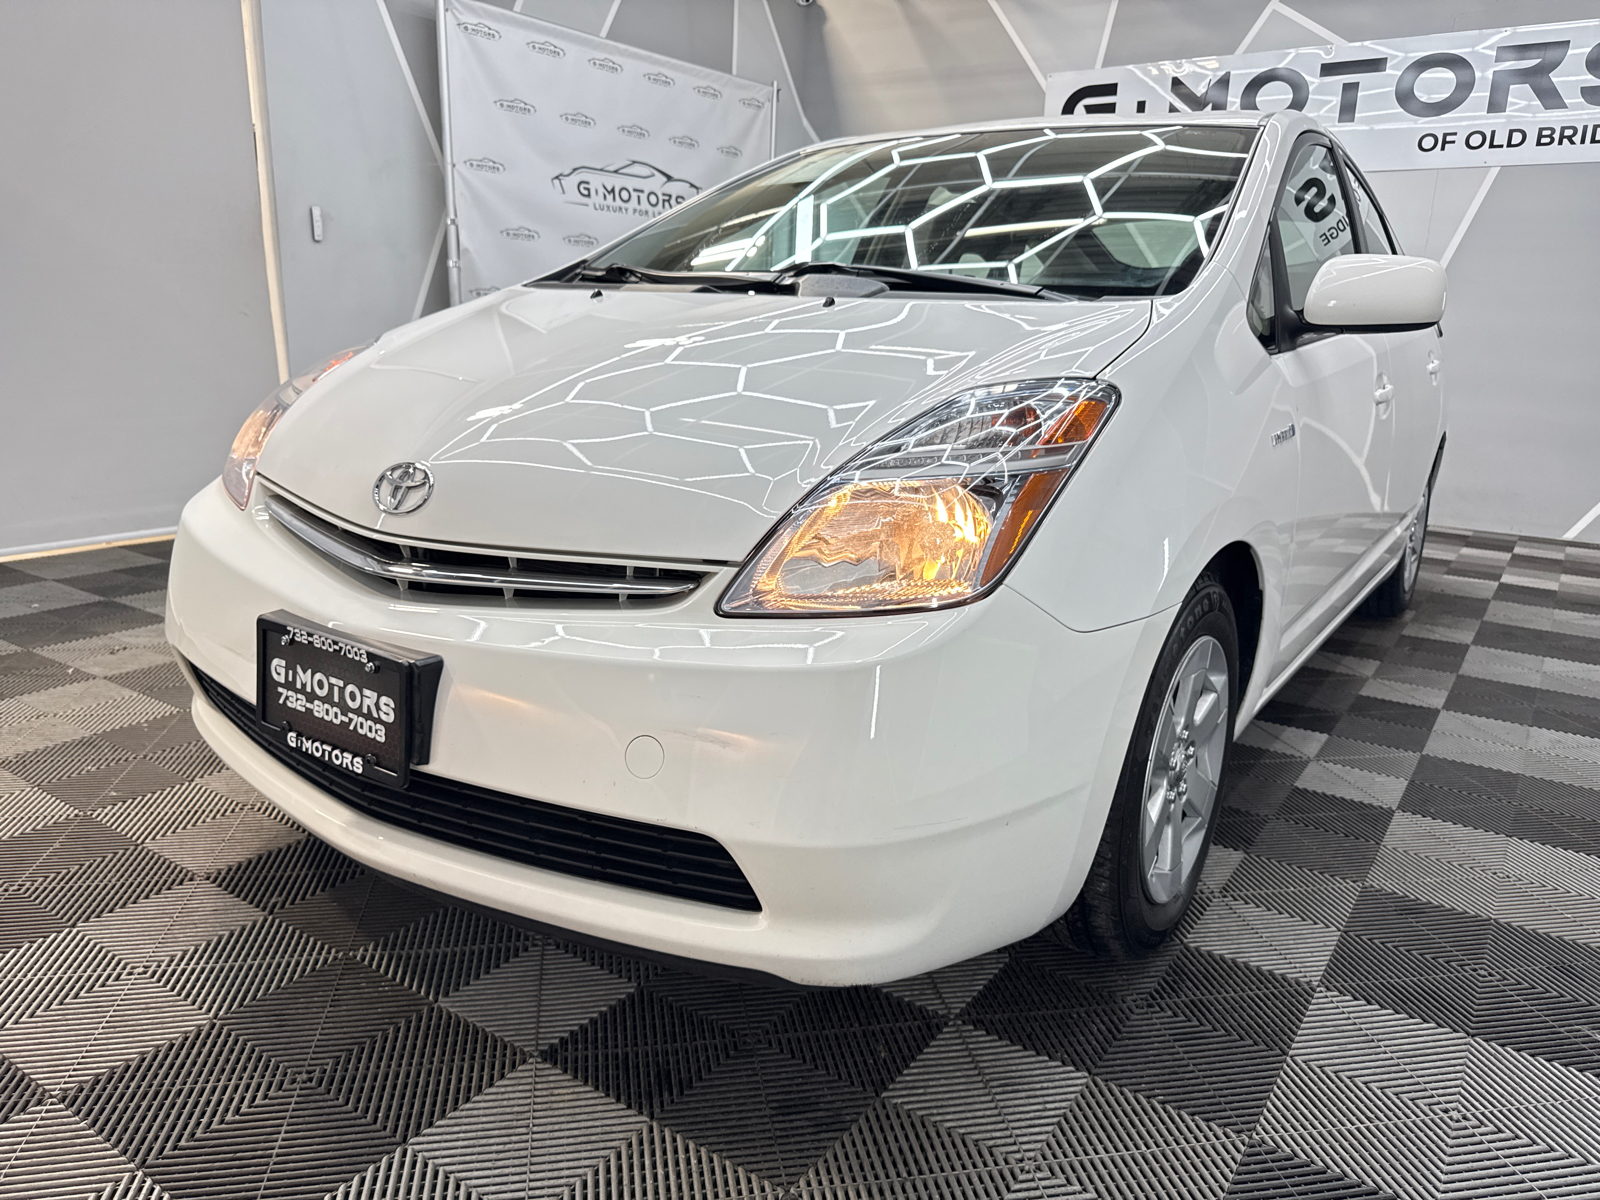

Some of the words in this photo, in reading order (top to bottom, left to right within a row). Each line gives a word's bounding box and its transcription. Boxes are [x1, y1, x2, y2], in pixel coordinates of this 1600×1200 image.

[1168, 40, 1600, 123] MOTOR
[1417, 132, 1457, 152] OF
[1465, 128, 1527, 150] OLD
[593, 202, 629, 214] LUXURY
[633, 208, 650, 218] FOR
[286, 626, 368, 663] 732-800-7003
[277, 687, 386, 743] 732-800-7003
[296, 664, 395, 723] MOTORS
